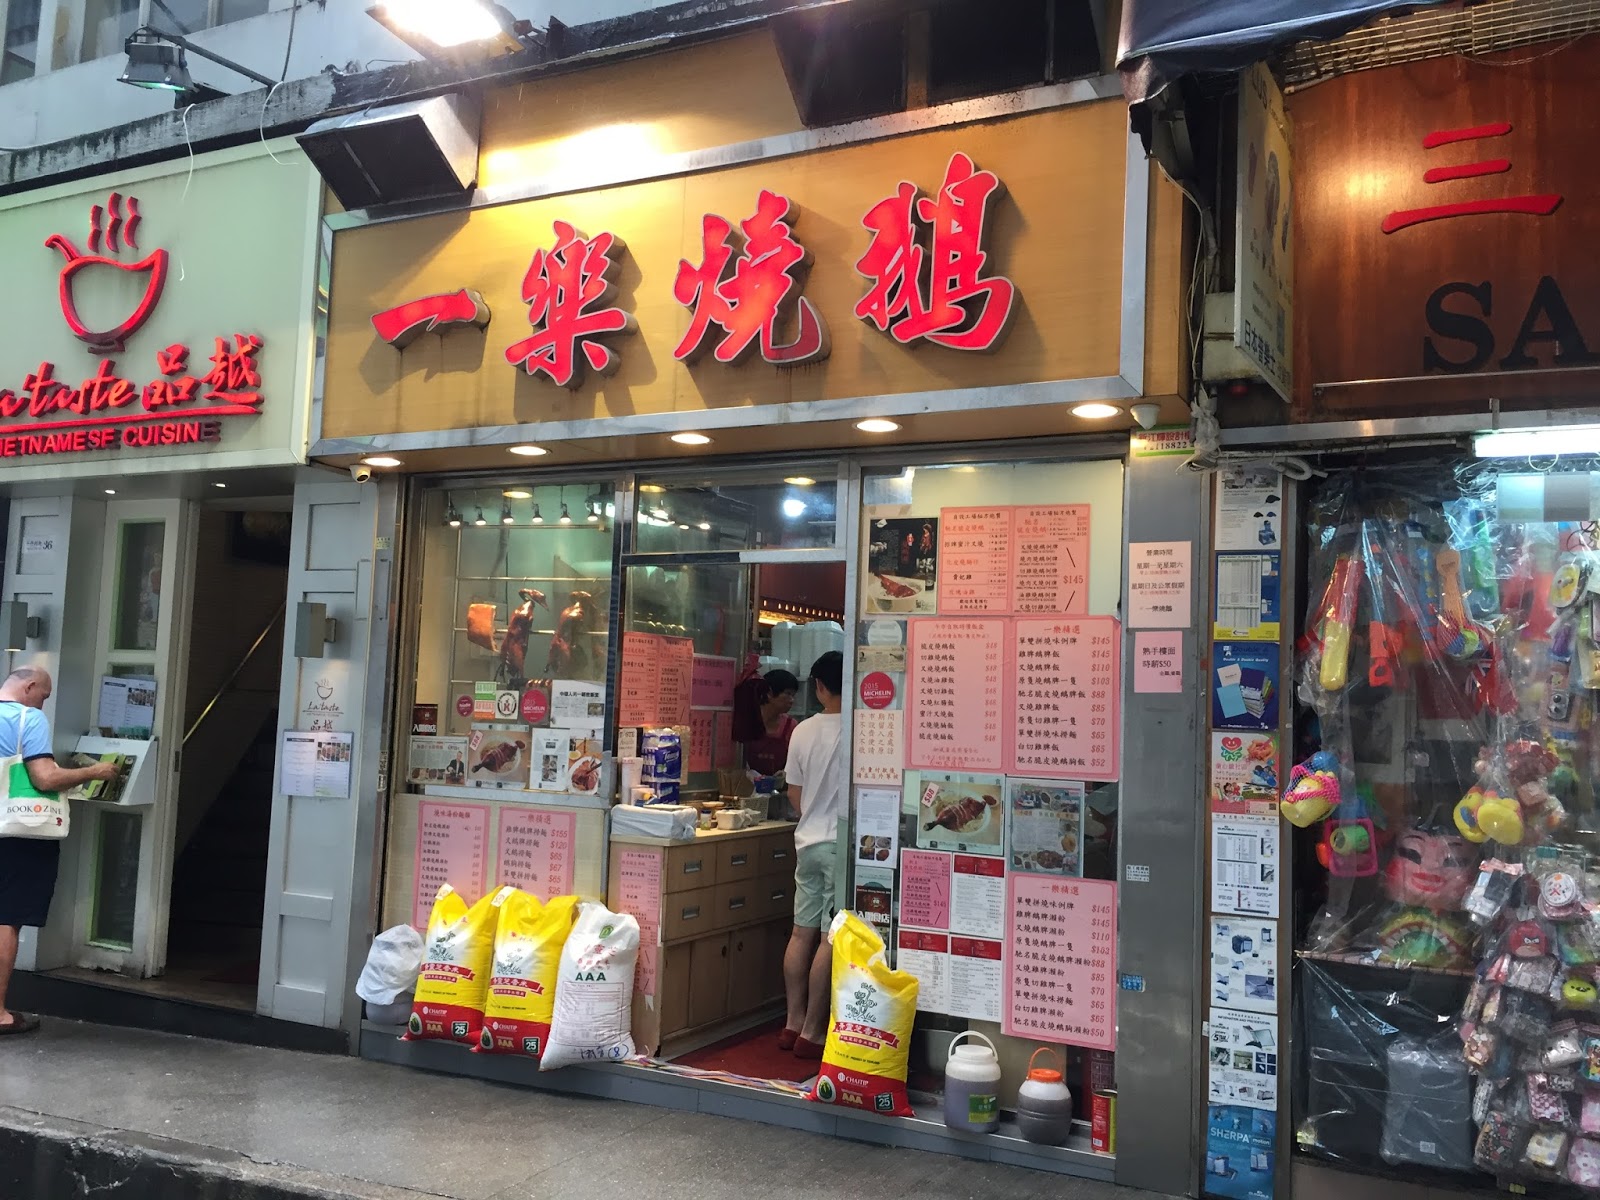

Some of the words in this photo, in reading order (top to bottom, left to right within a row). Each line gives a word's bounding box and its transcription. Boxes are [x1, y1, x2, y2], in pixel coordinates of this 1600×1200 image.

[1382, 123, 1564, 234] 三
[370, 152, 1014, 386] 一樂燒鵝
[1424, 276, 1600, 371] SA
[141, 334, 264, 411] 品越
[122, 421, 221, 447] CUISINE
[1063, 575, 1083, 584] $145
[1044, 625, 1081, 634] 一樂精選
[1091, 637, 1110, 645] $145
[1091, 650, 1110, 658] $145
[1091, 663, 1110, 671] $110
[1091, 677, 1110, 685] $103
[1091, 691, 1105, 699] $88
[1091, 717, 1105, 725] $70
[1091, 731, 1105, 739] $65
[1091, 745, 1105, 753] $65
[1091, 759, 1105, 767] $52
[551, 829, 567, 838] $155
[550, 841, 567, 849] $120
[549, 863, 562, 871] $67
[1042, 885, 1079, 896] 一樂精選
[1091, 905, 1110, 914] $145
[1091, 918, 1110, 928] $145
[1091, 932, 1110, 941] $110
[1091, 959, 1105, 968] $88
[575, 972, 606, 982] AAA
[1091, 973, 1105, 982] $85
[1091, 986, 1105, 996] $70
[1091, 1000, 1105, 1010] $65
[1090, 1014, 1105, 1023] $65
[454, 1025, 466, 1035] 25
[1090, 1028, 1104, 1037] $50
[525, 1041, 537, 1050] 25
[845, 1076, 869, 1086] CHAITIP
[879, 1098, 890, 1107] 25
[1210, 1127, 1250, 1144] SHERPA
